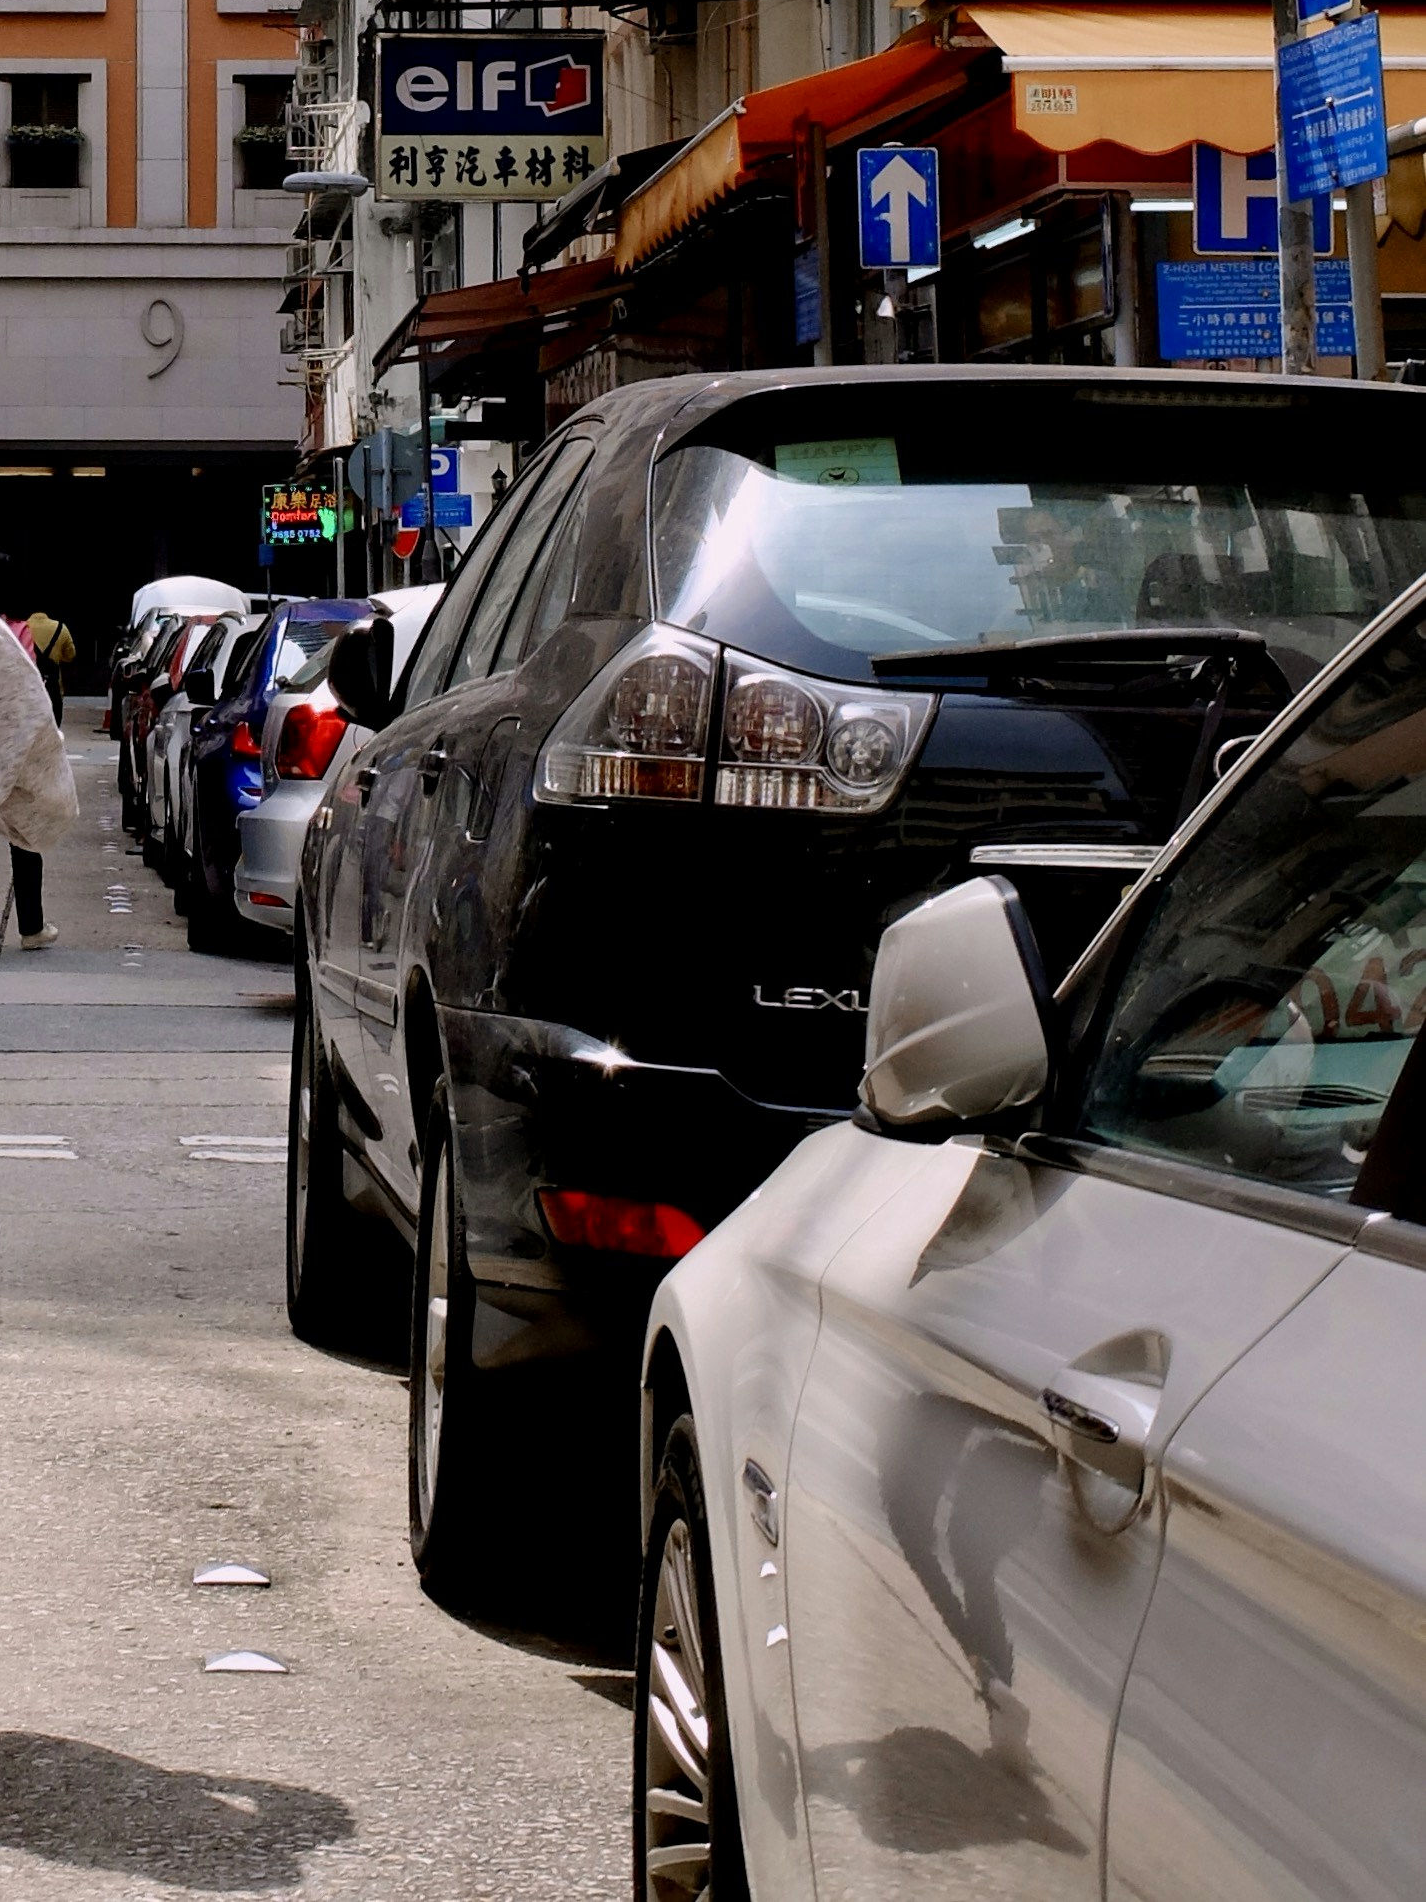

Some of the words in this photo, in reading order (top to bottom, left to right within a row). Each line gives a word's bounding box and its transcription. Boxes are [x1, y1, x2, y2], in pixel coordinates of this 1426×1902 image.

[395, 61, 516, 112] elf
[1210, 262, 1255, 273] METERS
[140, 299, 185, 379] 9
[753, 985, 870, 1012] LEXU
